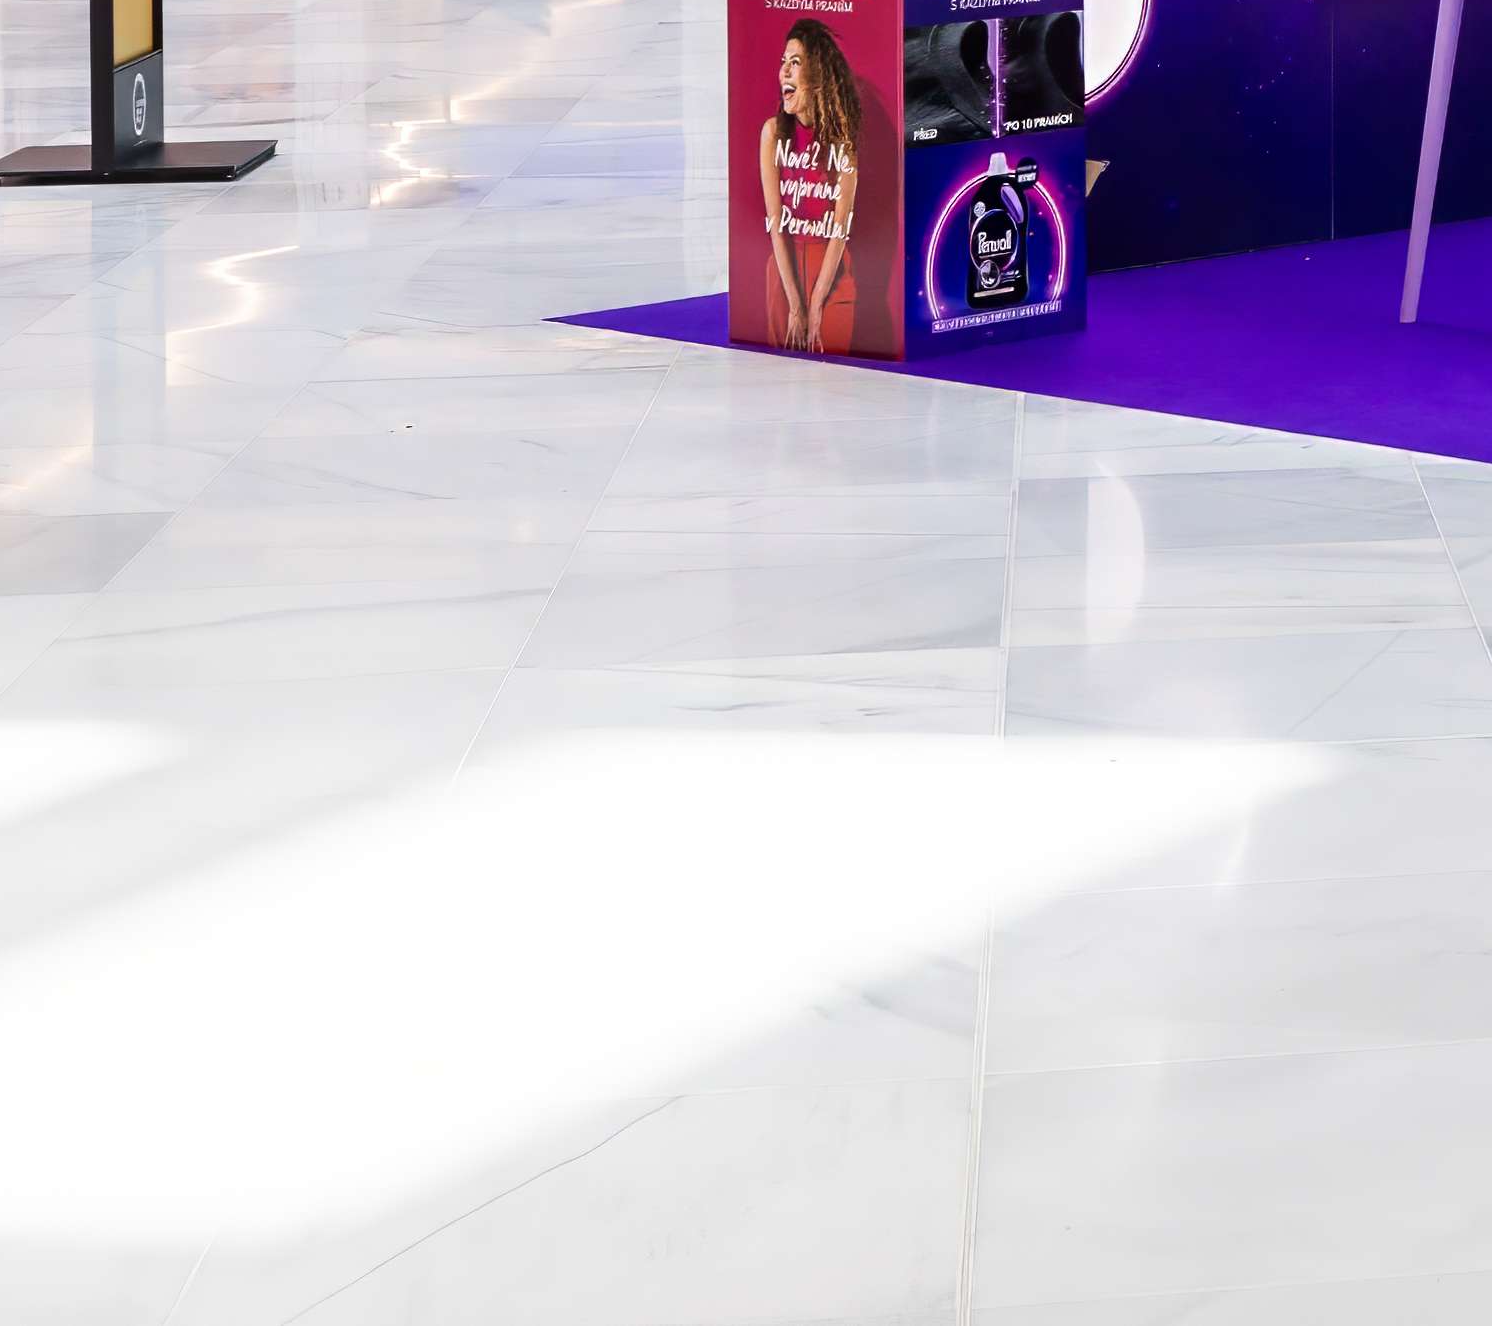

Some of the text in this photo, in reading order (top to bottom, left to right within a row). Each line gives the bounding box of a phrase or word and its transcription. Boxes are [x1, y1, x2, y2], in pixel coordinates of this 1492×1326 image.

[950, 0, 958, 11] S
[1022, 119, 1033, 130] 10
[774, 139, 855, 174] Nové? Ne,
[779, 176, 842, 210] vyprané
[765, 204, 854, 241] v Perwollu!
[977, 229, 1012, 255] Perwoll
